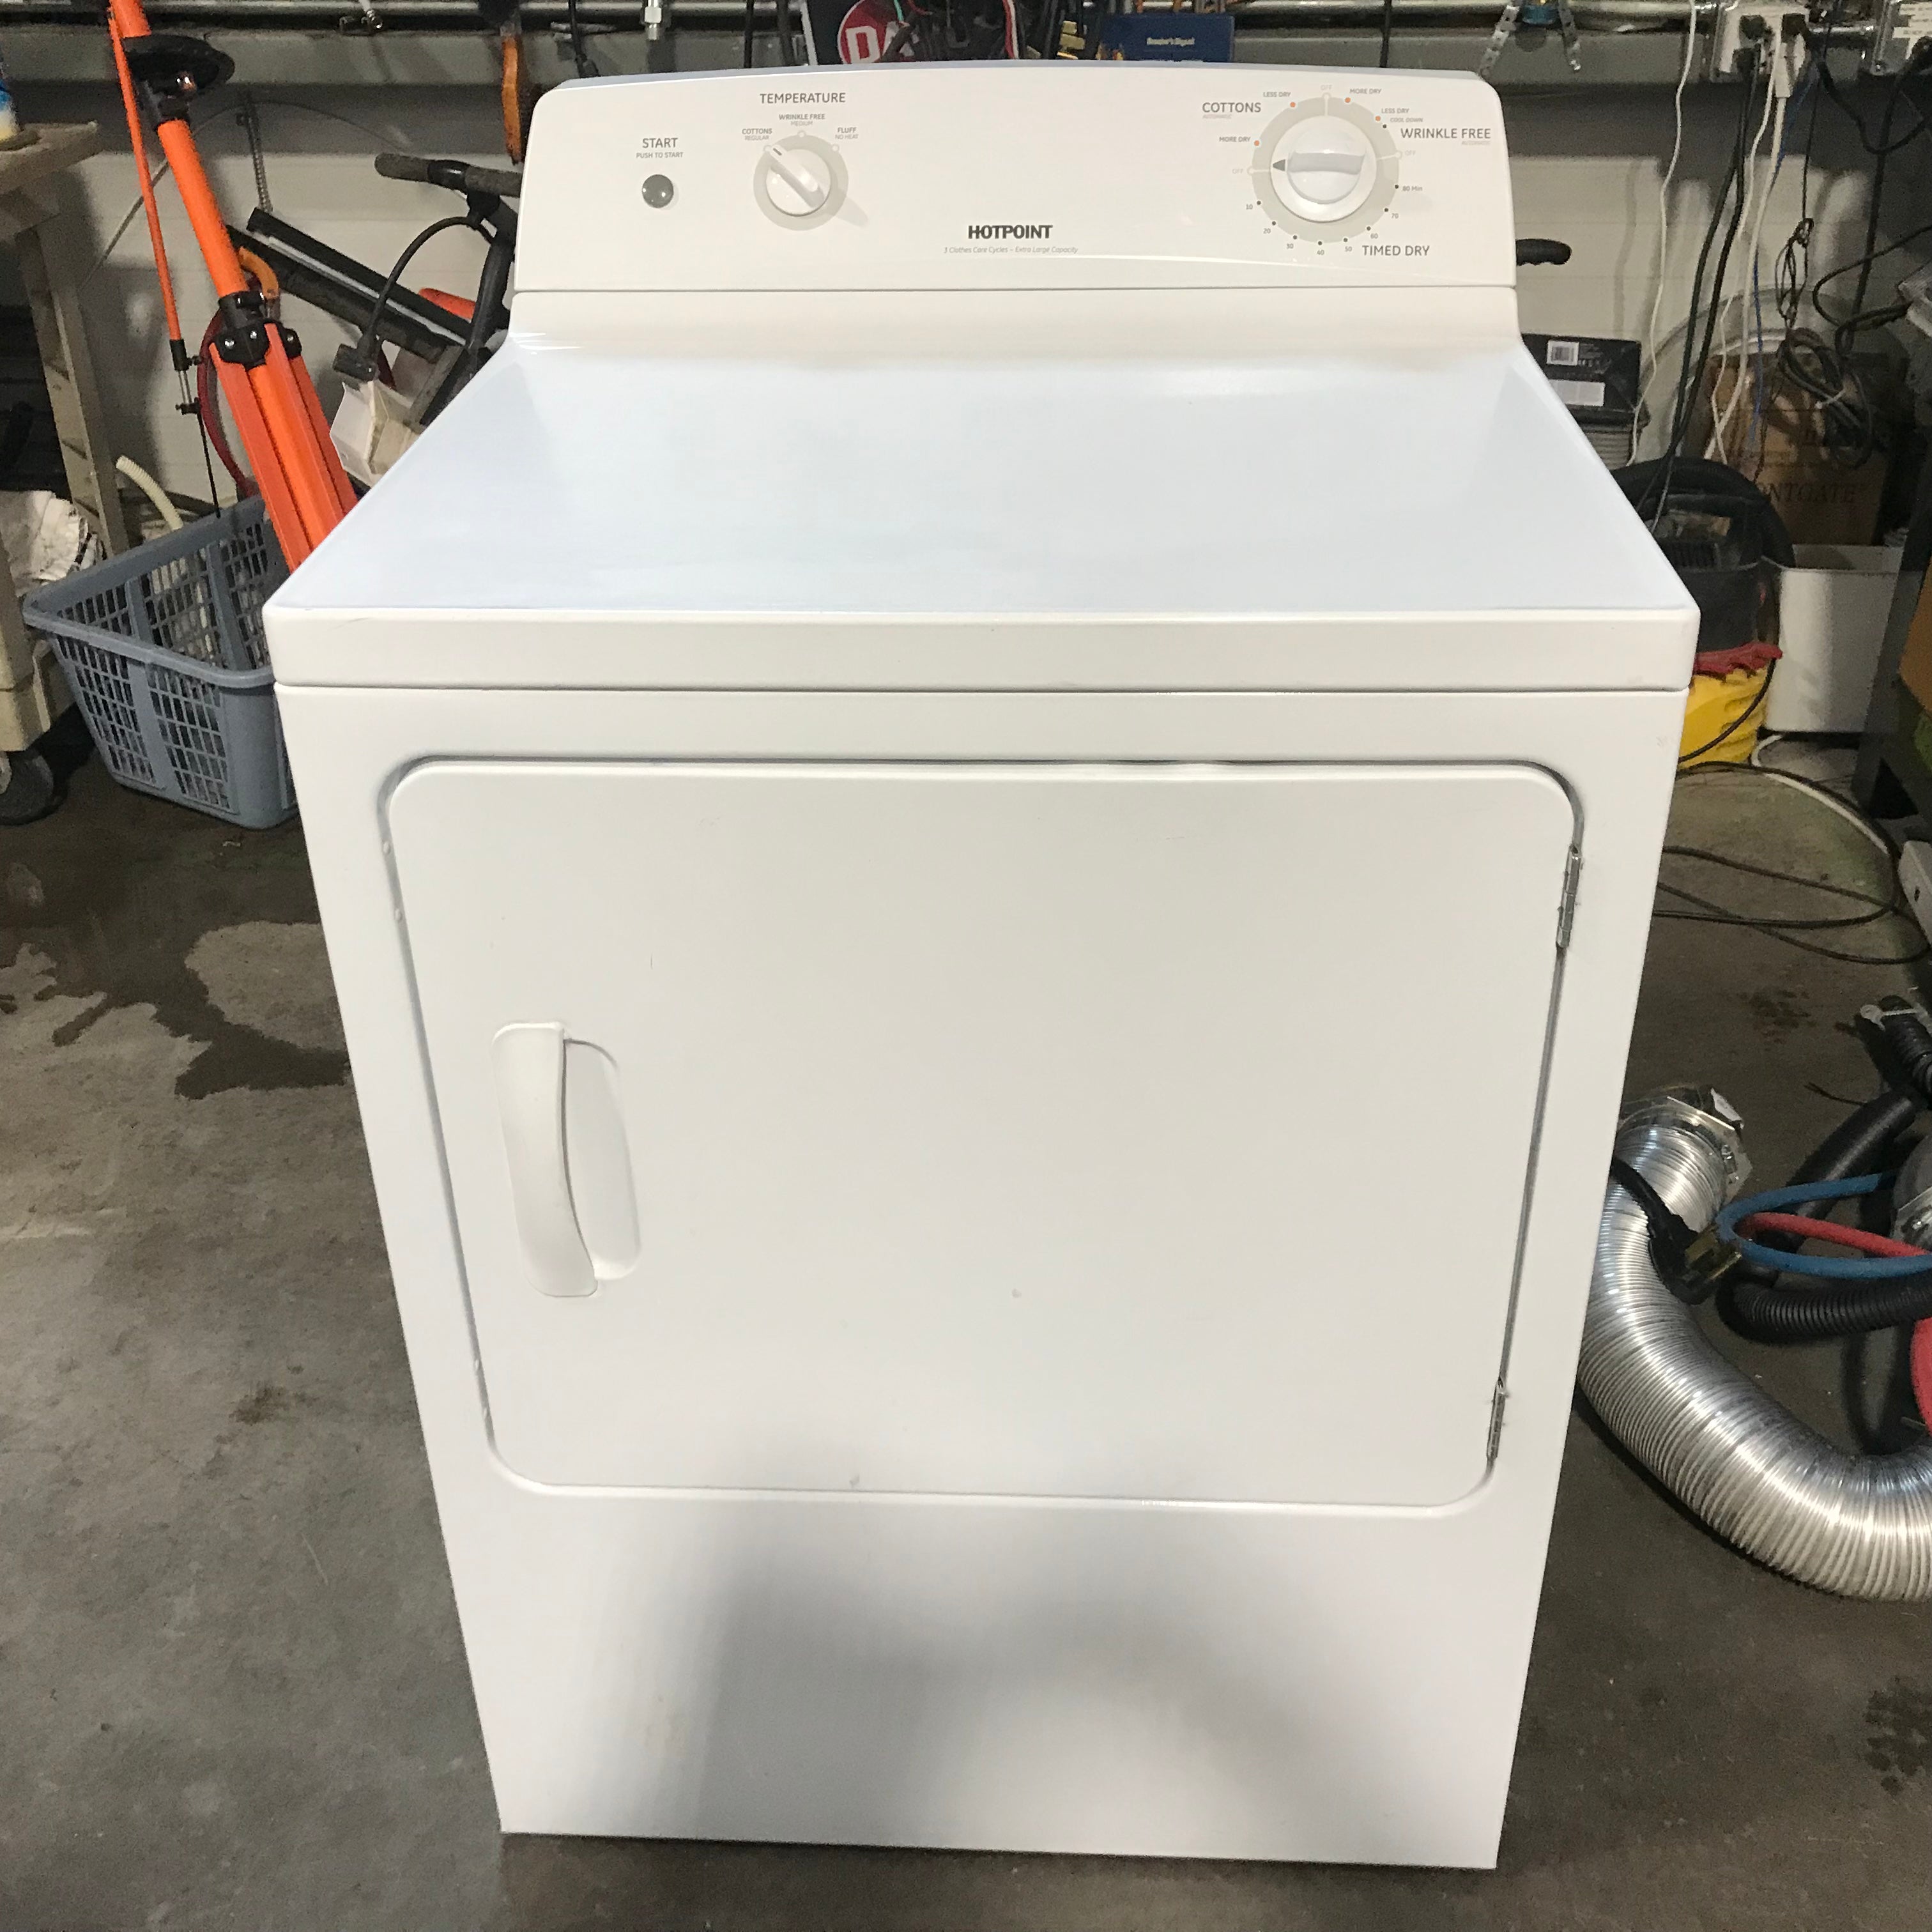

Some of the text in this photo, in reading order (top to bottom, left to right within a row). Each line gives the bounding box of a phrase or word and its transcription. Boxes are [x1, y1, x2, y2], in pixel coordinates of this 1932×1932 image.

[760, 92, 846, 103] TEMPERATURE
[1202, 102, 1262, 113] COTTONS
[1400, 128, 1491, 139] WRINKLE FREE
[642, 137, 678, 148] START
[968, 224, 1054, 240] HOTPOINT
[988, 246, 1008, 254] Cycles
[1051, 246, 1078, 254] Capacity
[1361, 245, 1430, 256] TIMED DRY
